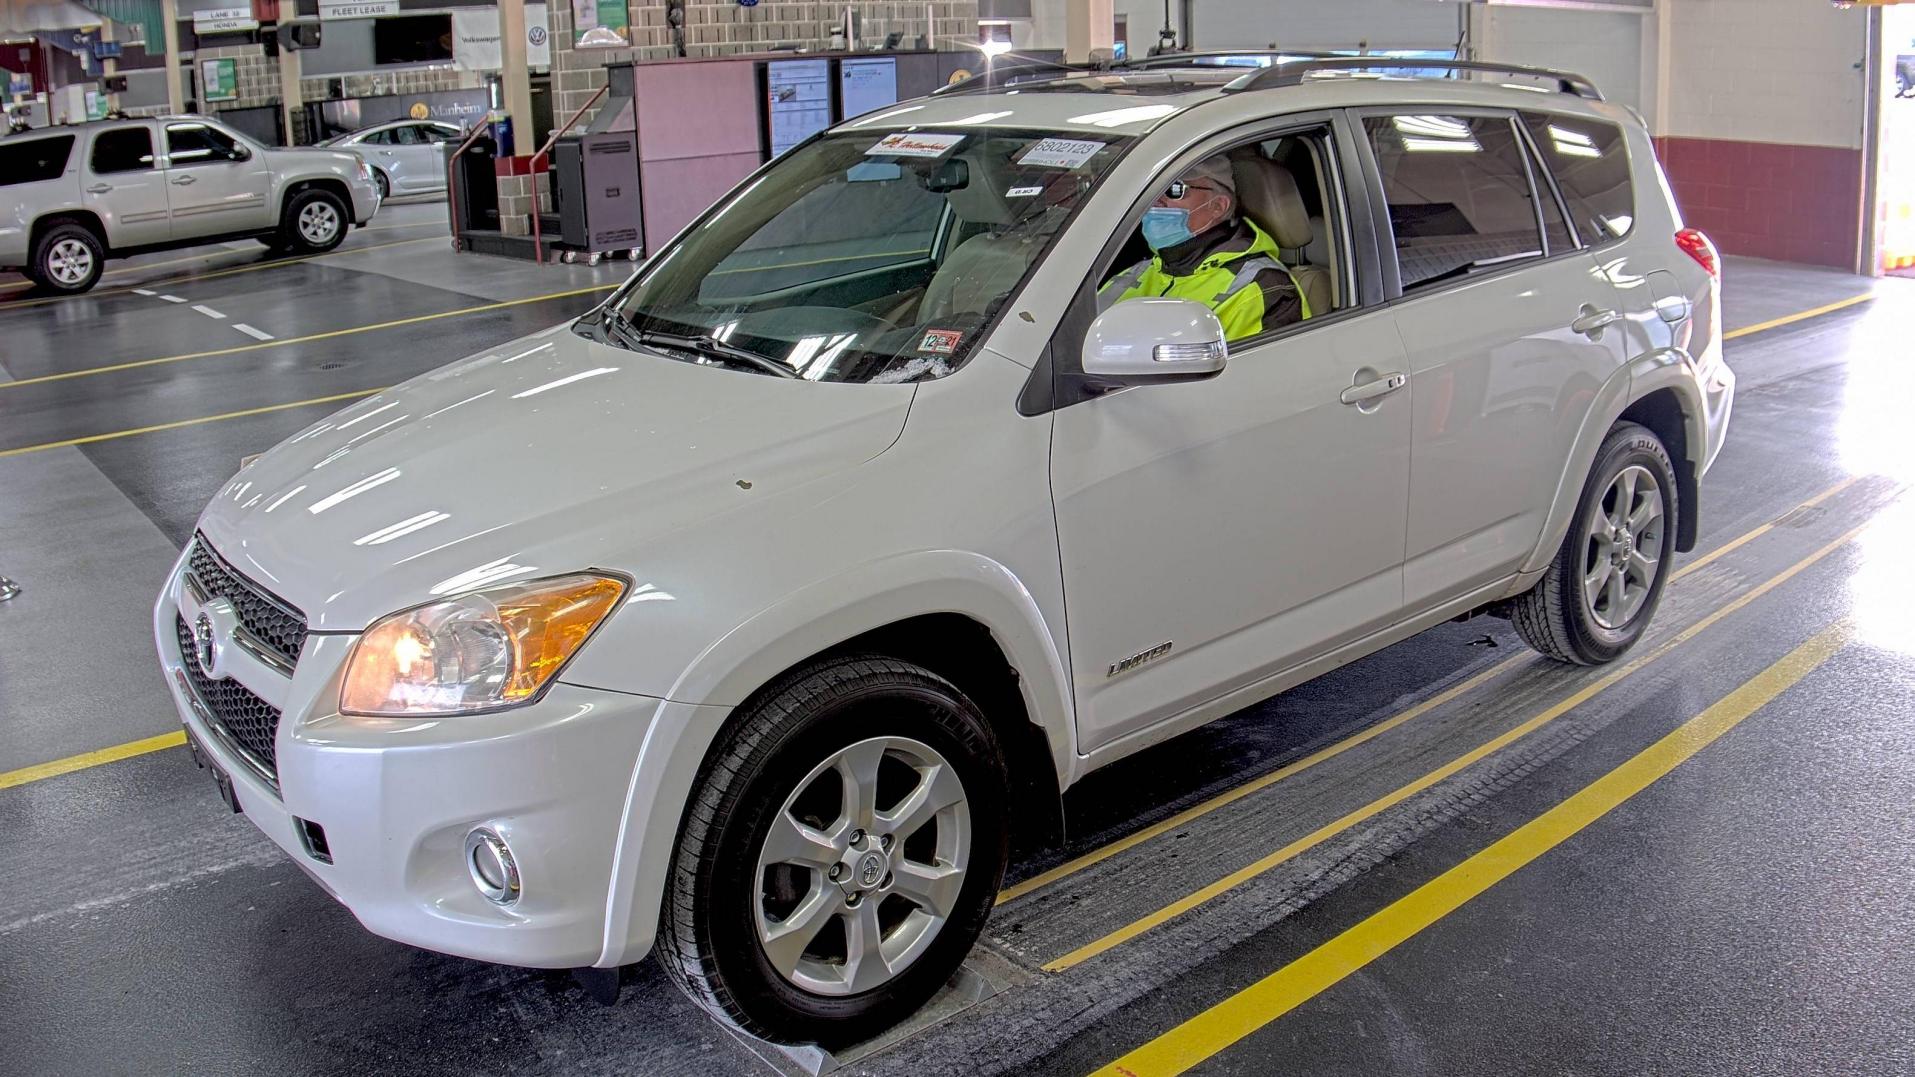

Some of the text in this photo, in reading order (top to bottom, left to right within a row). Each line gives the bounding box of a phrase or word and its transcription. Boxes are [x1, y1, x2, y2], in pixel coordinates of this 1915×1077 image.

[430, 102, 481, 117] Manheim
[1034, 140, 1095, 155] 6802123
[924, 334, 938, 347] 12
[1106, 640, 1173, 677] LIMITED
